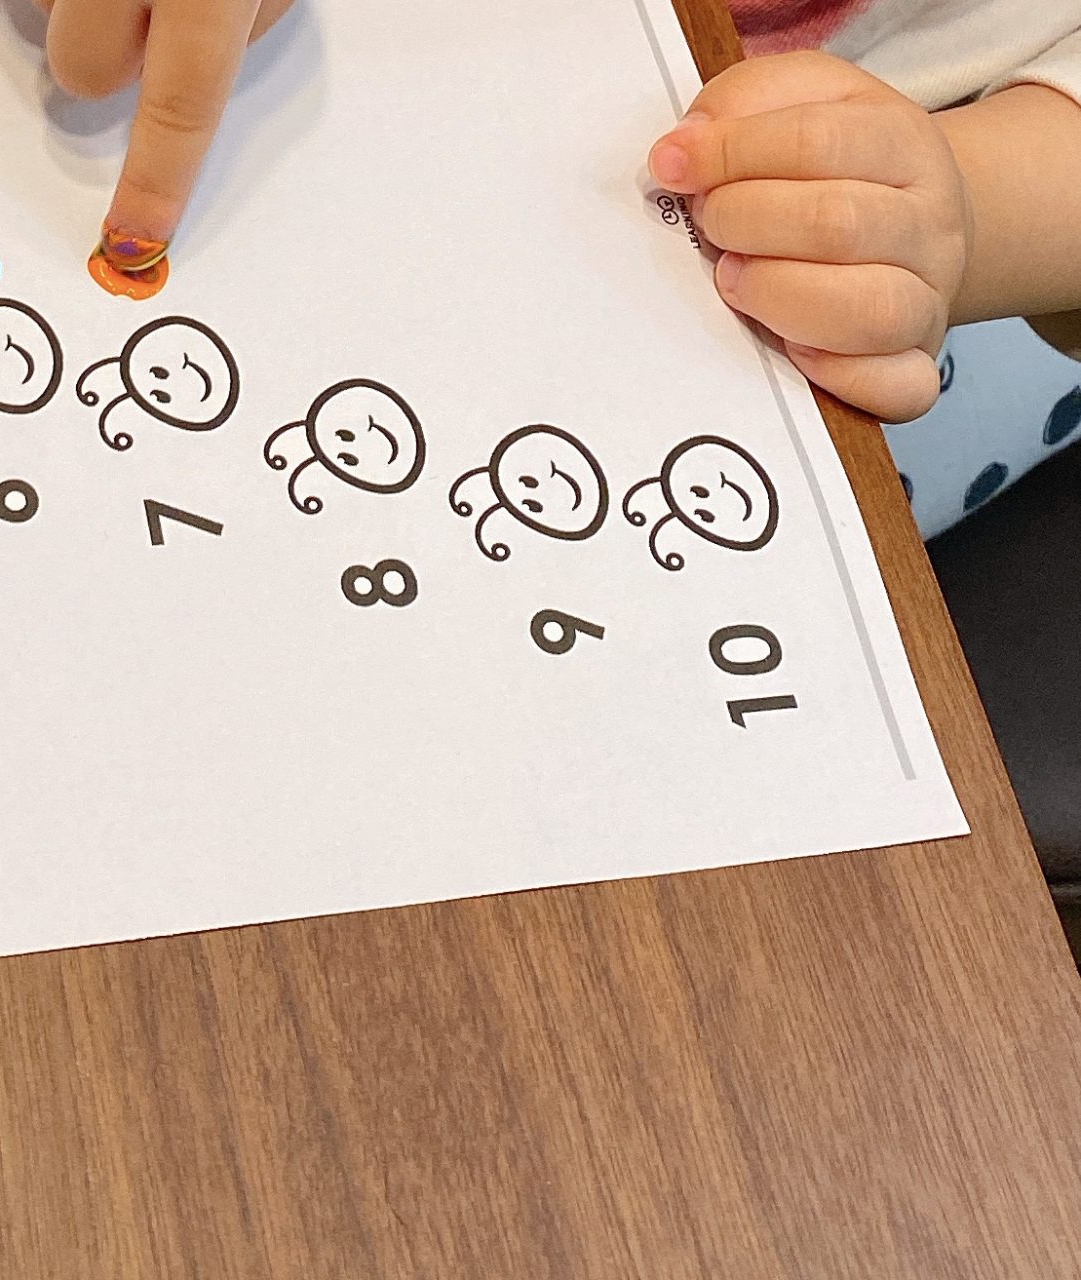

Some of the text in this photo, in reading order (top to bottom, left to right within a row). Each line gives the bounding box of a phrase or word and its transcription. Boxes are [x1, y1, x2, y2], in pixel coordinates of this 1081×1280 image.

[144, 499, 223, 545] 7
[341, 559, 418, 607] 8
[530, 609, 604, 654] 9
[709, 625, 797, 728] 10
